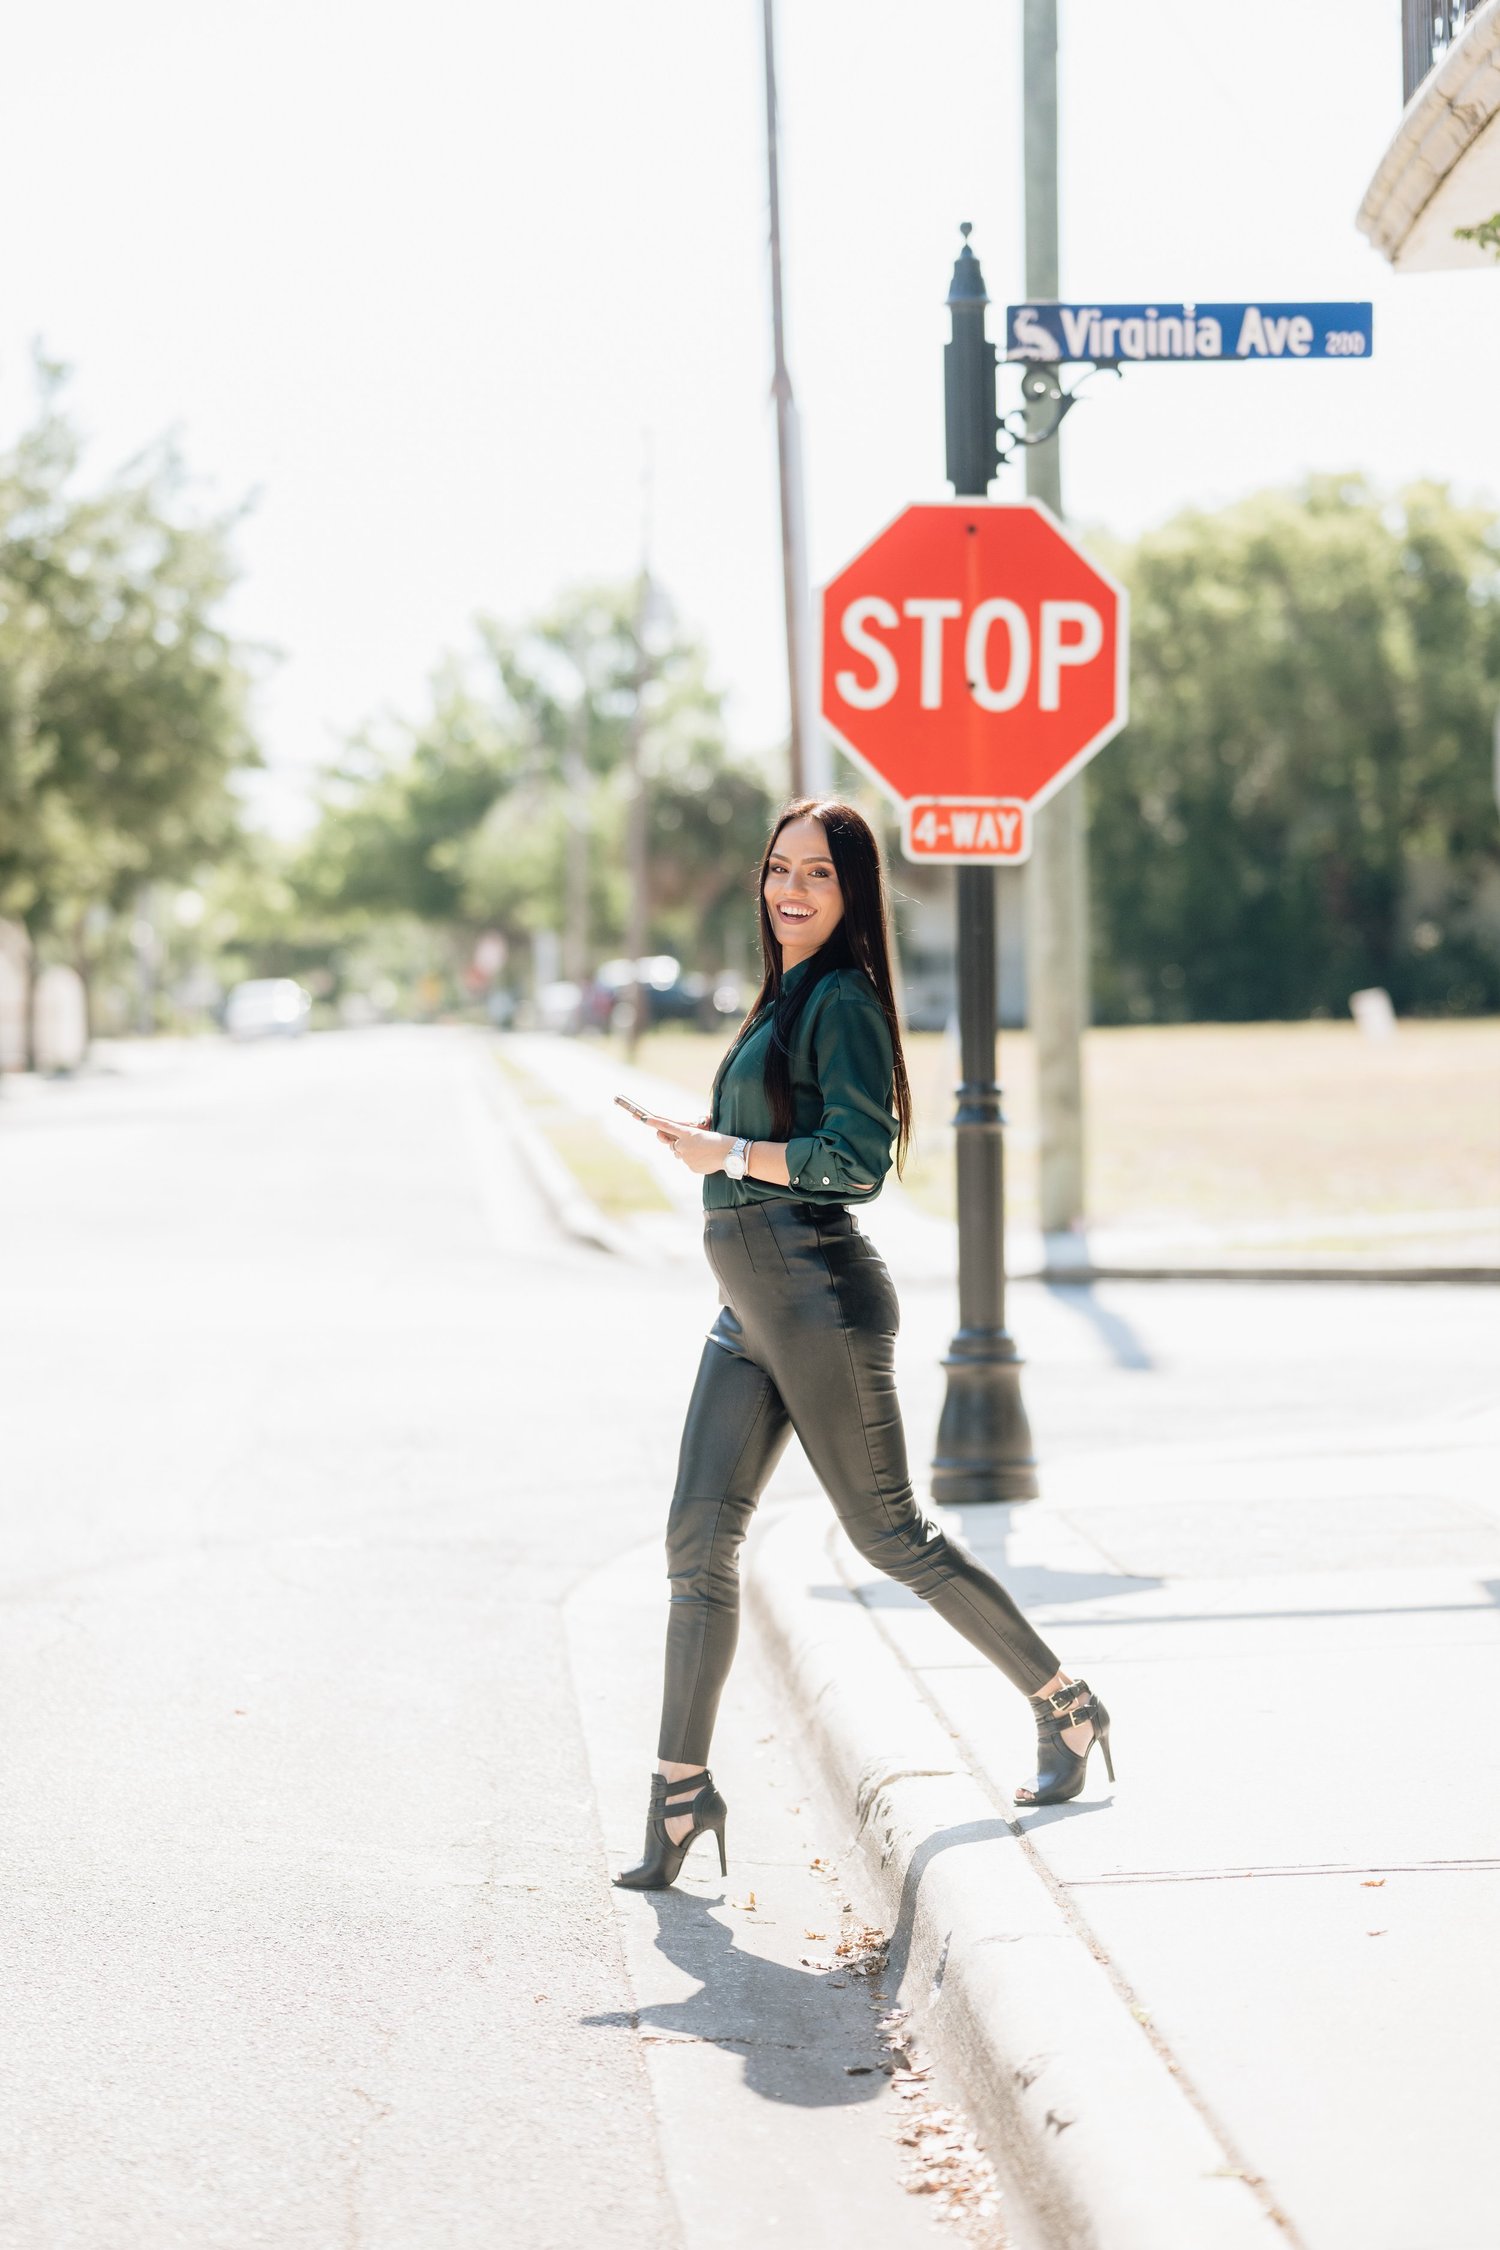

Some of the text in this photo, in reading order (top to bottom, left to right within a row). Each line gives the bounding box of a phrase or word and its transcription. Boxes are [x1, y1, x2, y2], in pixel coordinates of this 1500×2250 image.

[1060, 306, 1366, 360] Virginia Ave 200
[835, 596, 1104, 713] STOP
[913, 811, 1020, 848] 4-WAY
